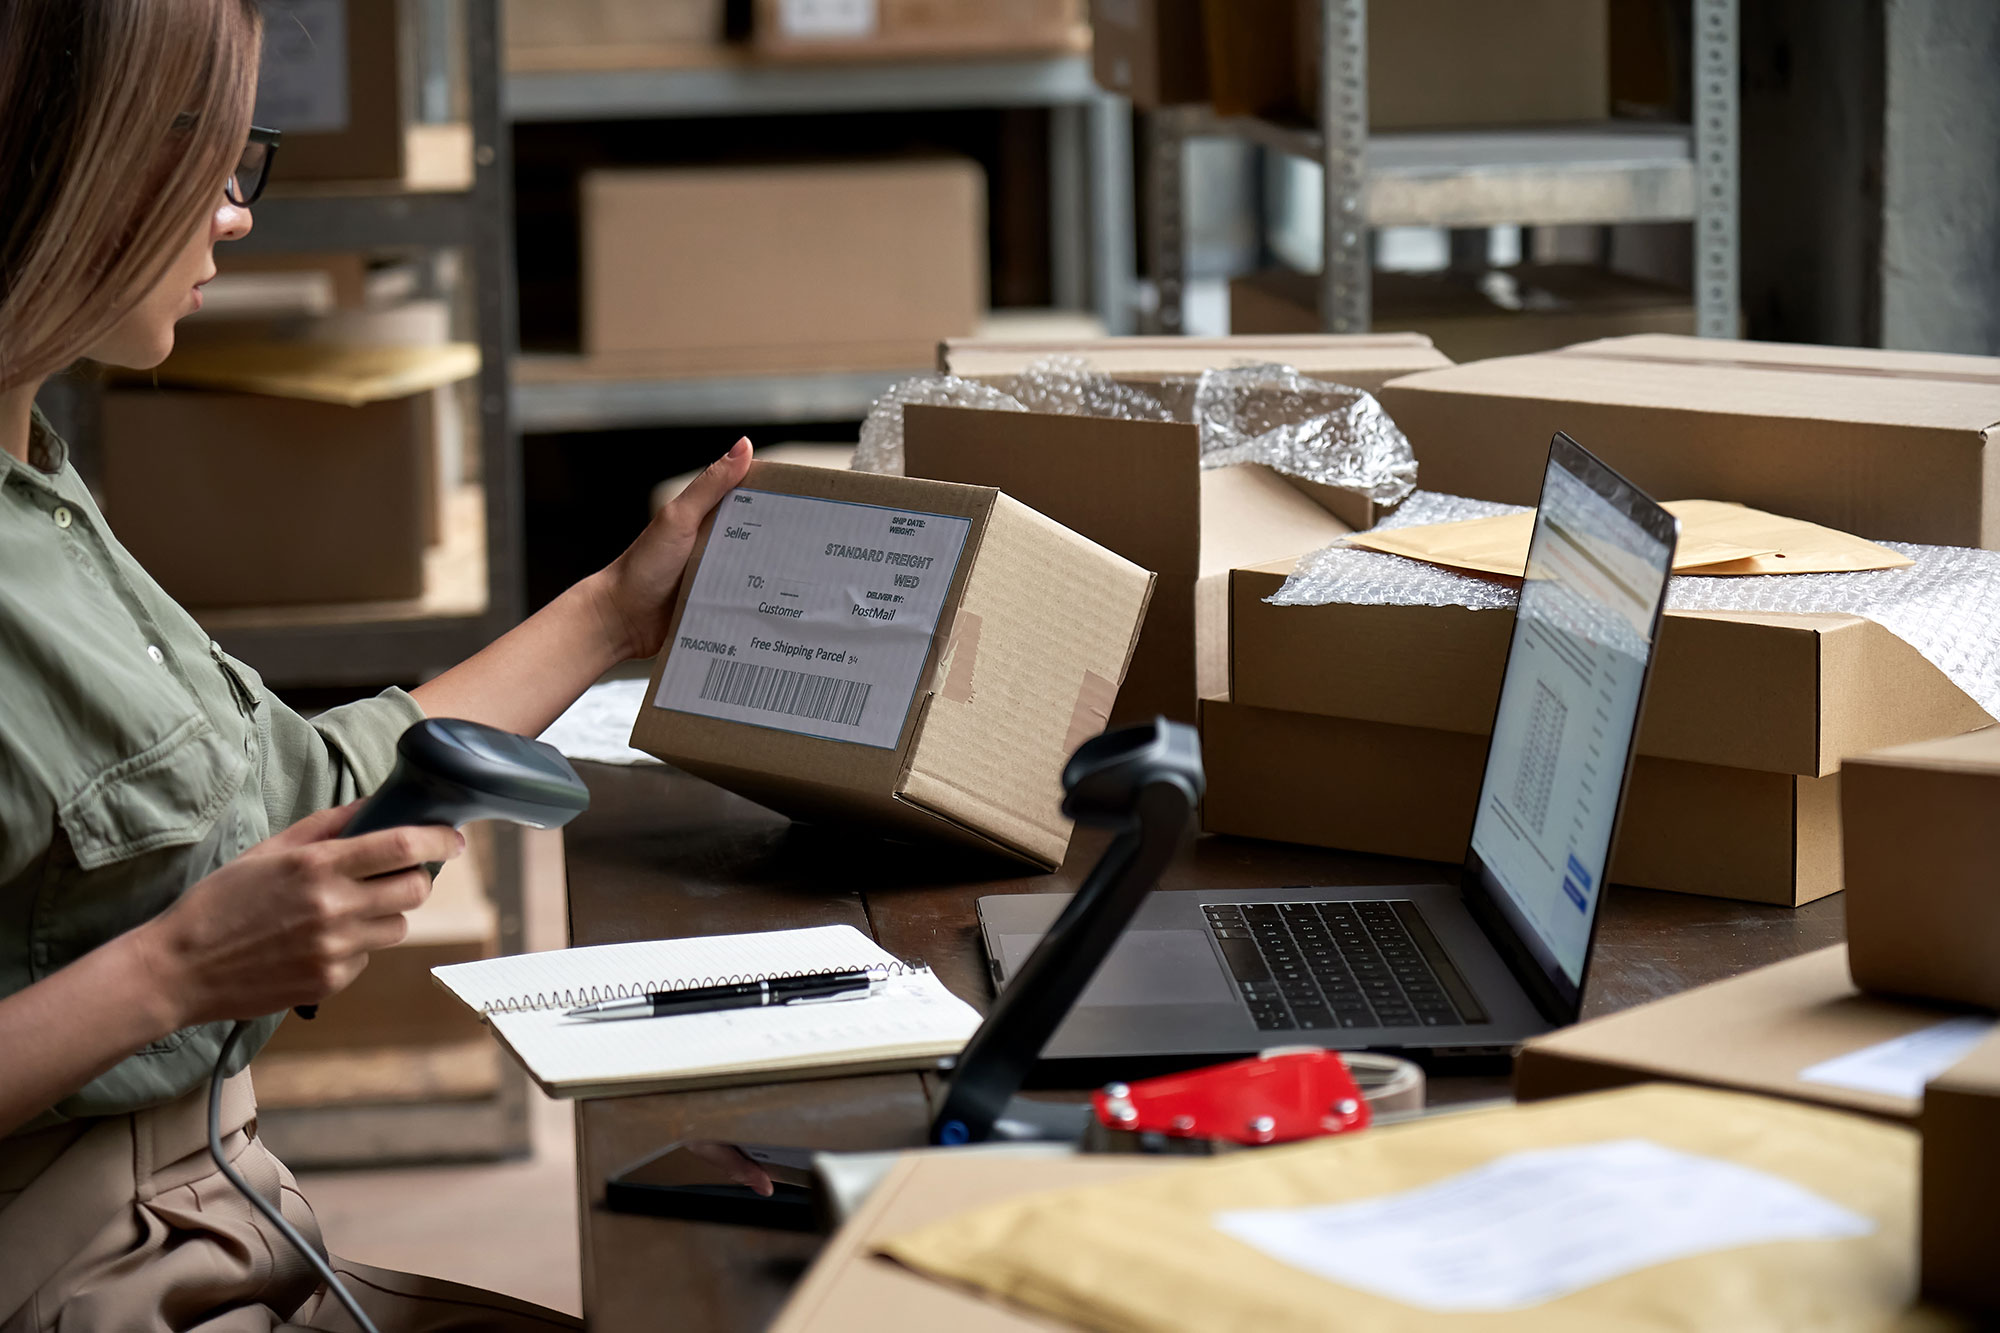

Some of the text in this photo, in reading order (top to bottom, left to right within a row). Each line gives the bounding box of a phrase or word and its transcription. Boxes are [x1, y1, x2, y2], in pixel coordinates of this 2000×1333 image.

[734, 494, 753, 504] FROM:
[892, 517, 926, 528] SHIP DATE:
[724, 526, 751, 540] Seller
[889, 526, 915, 536] WEIGHT:
[825, 543, 934, 570] STANDARD FREIGHT
[747, 575, 765, 589] TO:
[893, 574, 920, 589] WED
[866, 591, 904, 603] DELIVER BY:
[758, 602, 803, 619] Customer
[852, 604, 896, 621] PostMail
[680, 637, 737, 656] TRACKING #:
[750, 637, 771, 651] Free
[773, 641, 813, 660] Shipping
[815, 648, 846, 663] Parcel
